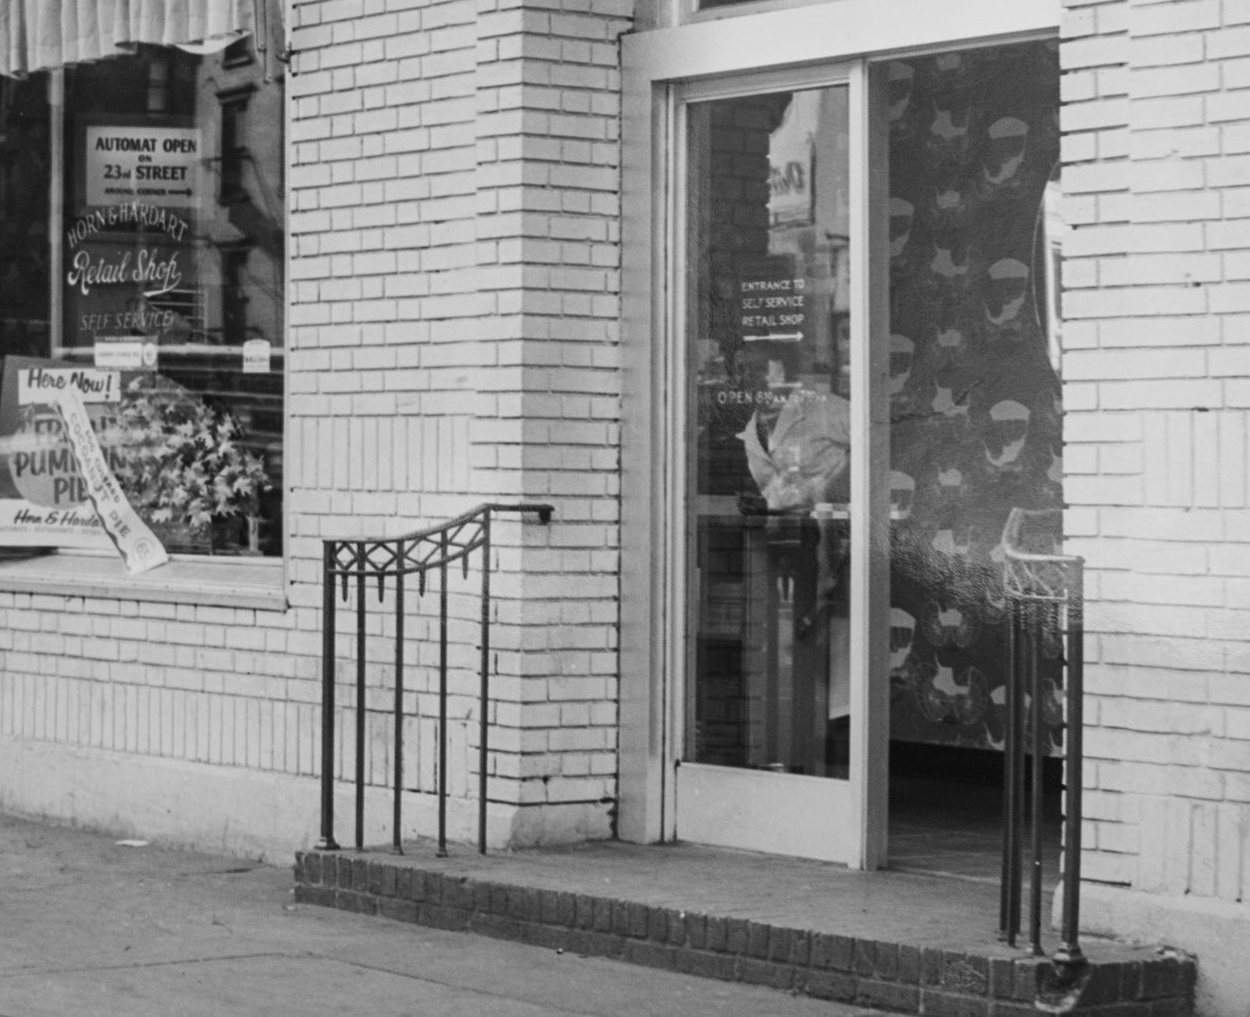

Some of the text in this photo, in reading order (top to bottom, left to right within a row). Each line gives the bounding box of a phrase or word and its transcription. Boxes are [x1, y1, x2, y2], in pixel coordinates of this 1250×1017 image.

[95, 137, 197, 153] AUTOMAT OPEN
[138, 154, 152, 163] ON
[135, 165, 188, 181] STREET
[119, 201, 189, 242] HARDART
[67, 248, 182, 297] Retail Shop
[741, 280, 791, 292] ENTRANCE
[741, 315, 777, 326] RETAIL
[28, 367, 66, 389] Here
[717, 391, 753, 404] OPEN
[109, 509, 132, 539] PIE
